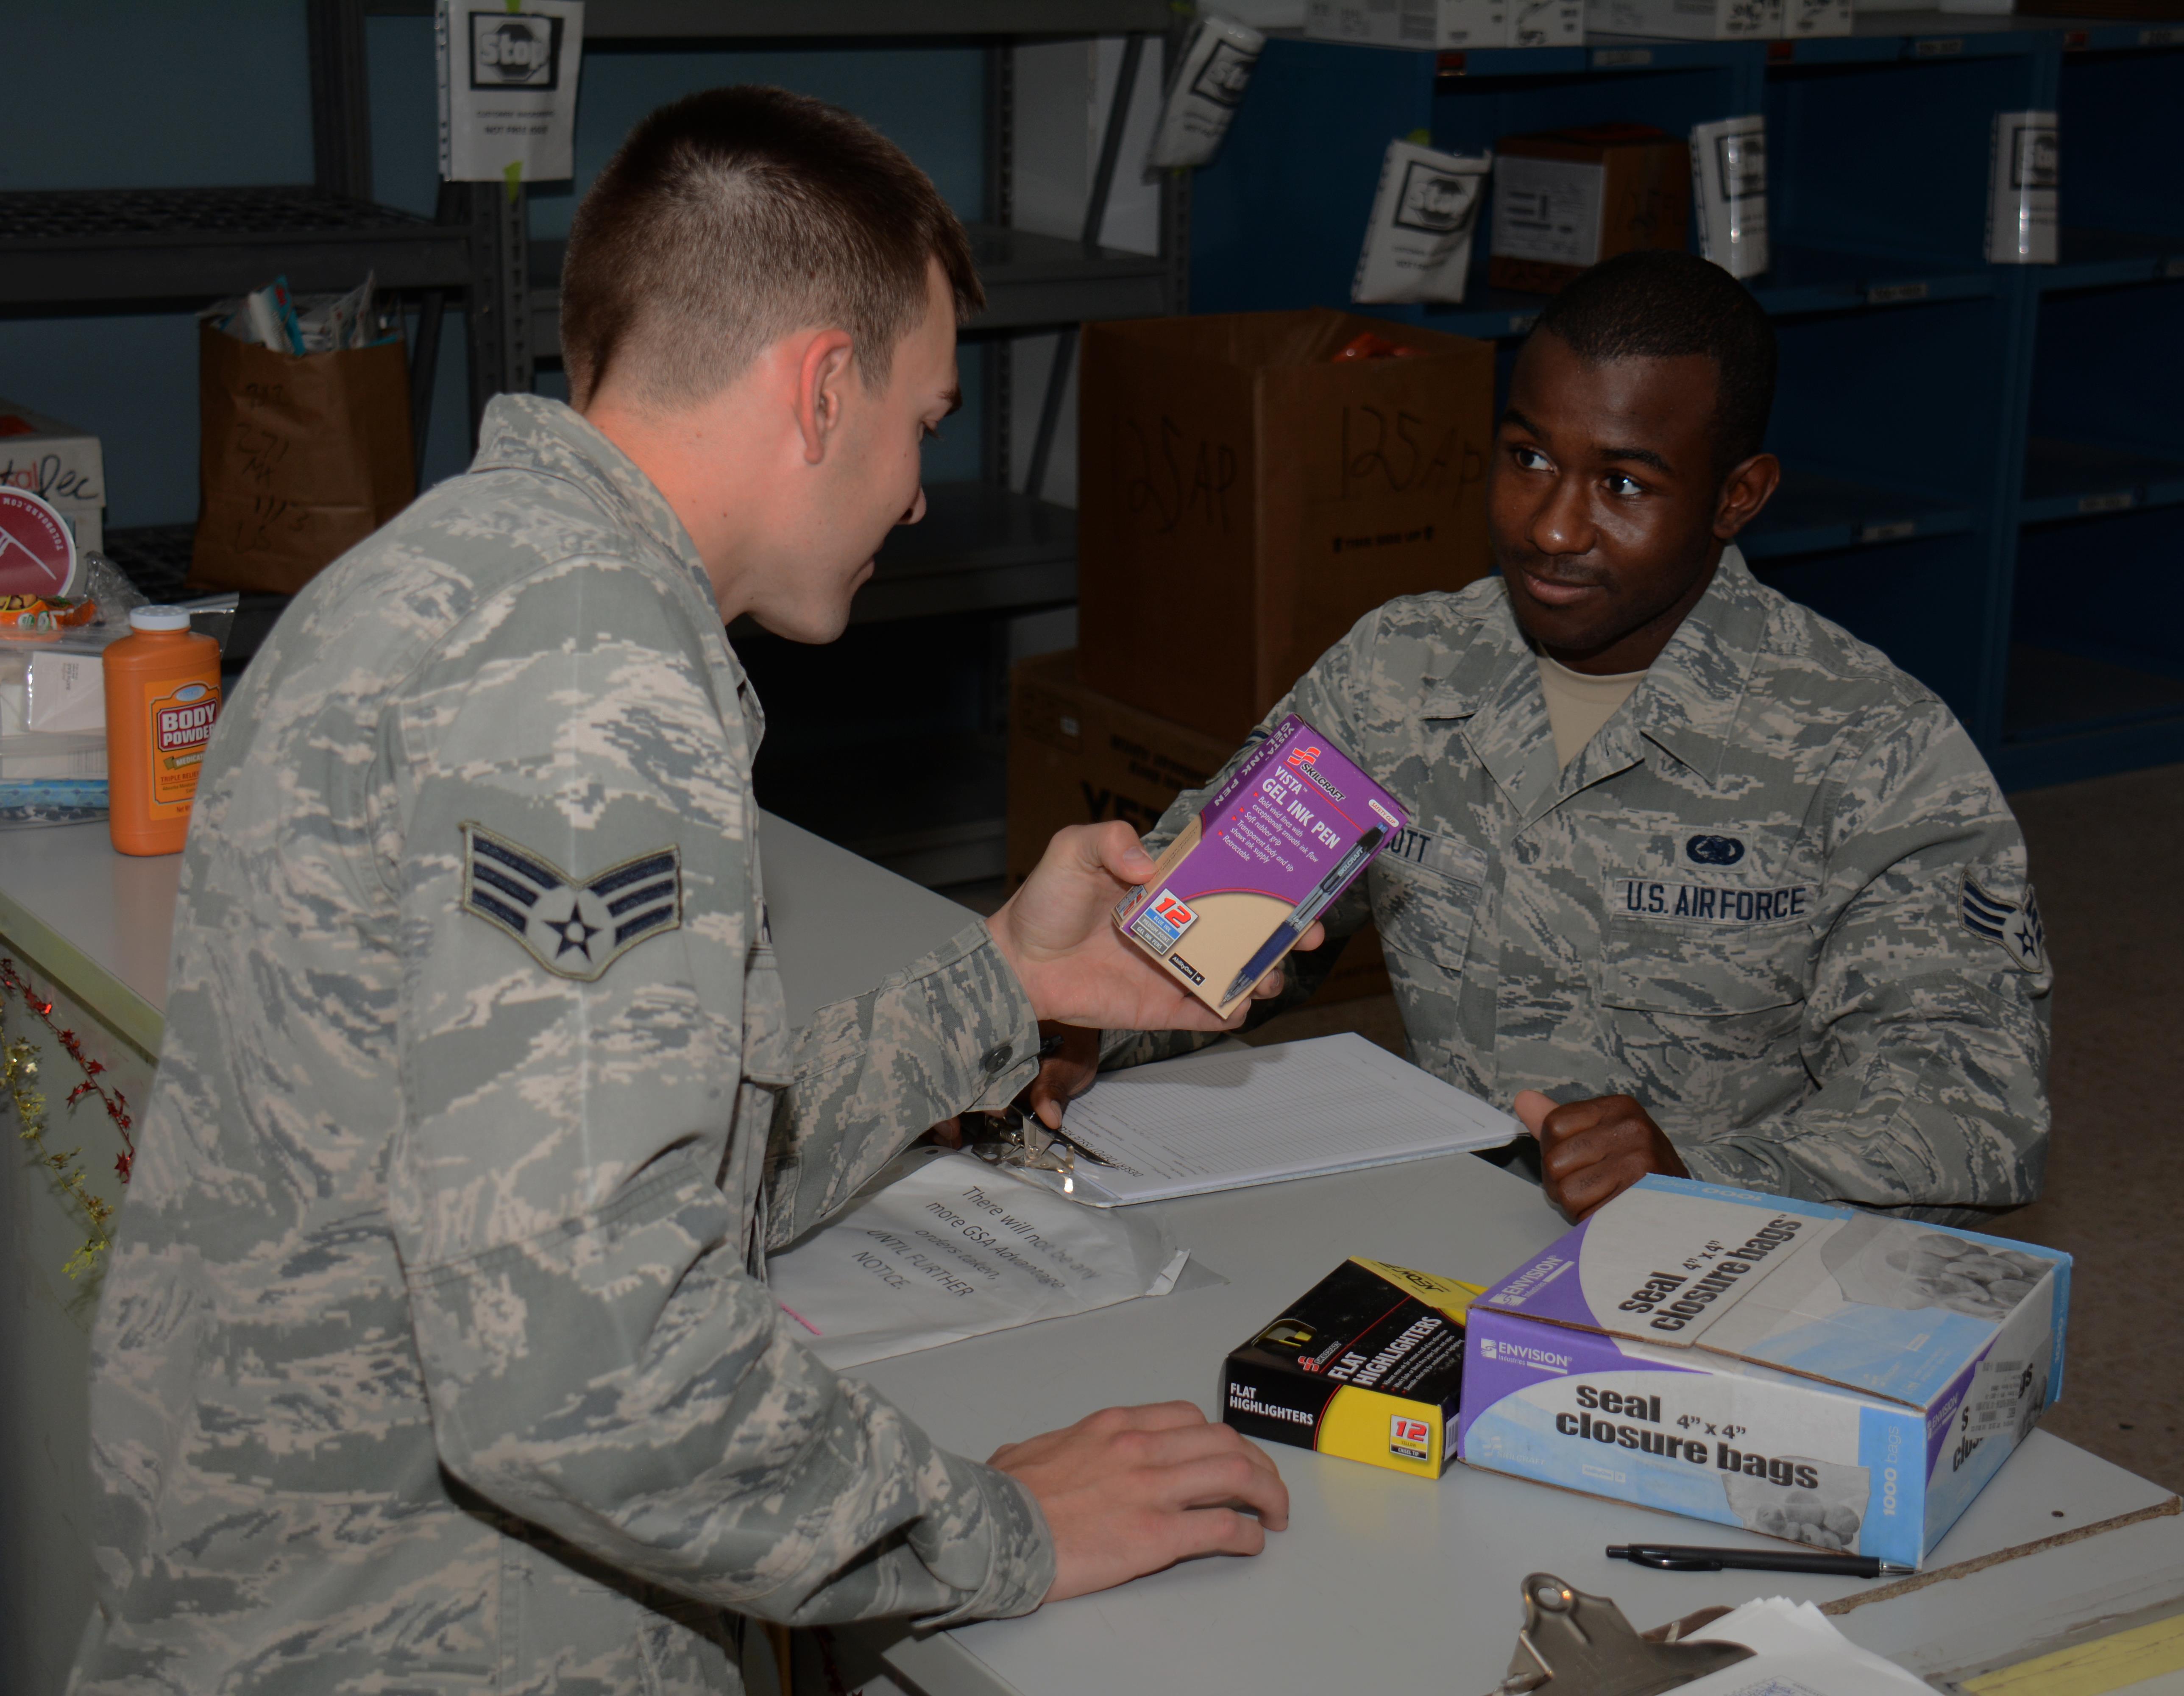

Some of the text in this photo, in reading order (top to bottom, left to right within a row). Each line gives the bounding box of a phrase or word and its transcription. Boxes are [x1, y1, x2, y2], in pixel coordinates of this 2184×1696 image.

[162, 703, 216, 733] BODY
[161, 775, 181, 783] TRIPLE
[1214, 722, 1290, 806] GEL INK PEN
[1301, 763, 1346, 801] SKILCRAFT
[1258, 796, 1303, 837] Bold vivid lines with
[1262, 778, 1341, 849] GEL INK PEN
[1371, 802, 1396, 824] SAFETY CLIP
[1237, 819, 1265, 848] Transparent
[1264, 844, 1277, 858] body
[1276, 856, 1289, 866] and
[1244, 812, 1281, 846] Soft rubber grip
[1252, 804, 1319, 862] exceptionally smooth ink flow
[1223, 835, 1250, 862] Retractable
[1230, 828, 1270, 863] shows ink supply
[1337, 846, 1364, 877] SKILCRAFT
[1156, 897, 1192, 929] 12
[1627, 881, 1806, 921] U.S. AIR FORCE
[1137, 926, 1163, 950] GEL INK PENS
[1142, 918, 1170, 943] MEDIUM POINT
[1153, 915, 1172, 933] BLUE INK
[1172, 956, 1193, 976] AbilityOne
[1651, 1179, 1763, 1201] 1000 bags
[962, 1186, 1003, 1216] There
[1000, 1215, 1035, 1234] will
[1024, 1234, 1055, 1252] not
[915, 1230, 962, 1255] orders
[925, 1202, 1065, 1288] more GSA Advantage
[852, 1251, 911, 1290] NOTICE.
[867, 1230, 975, 1297] UNTIL FURTHER
[1618, 1271, 1689, 1314] seal
[1649, 1261, 1751, 1331] closure
[1315, 1341, 1342, 1365] SKILCRAFT
[1327, 1351, 1368, 1380] FLAT
[1352, 1316, 1442, 1386] HIGHLIGHTERS
[1498, 1355, 1526, 1365] Industries
[1230, 1382, 1257, 1400] FLAT
[1229, 1396, 1314, 1426] HIGHLIGHTERS
[1576, 1384, 1660, 1423] seal
[1705, 1423, 1717, 1436] x
[1396, 1420, 1427, 1442] 12
[1401, 1439, 1417, 1448] YELLOW
[1398, 1446, 1412, 1454] CHISEL
[1497, 1450, 1545, 1465] SKILCRAFT
[1555, 1411, 1819, 1490] closure bags
[1883, 1425, 1901, 1516] 1000 bags
